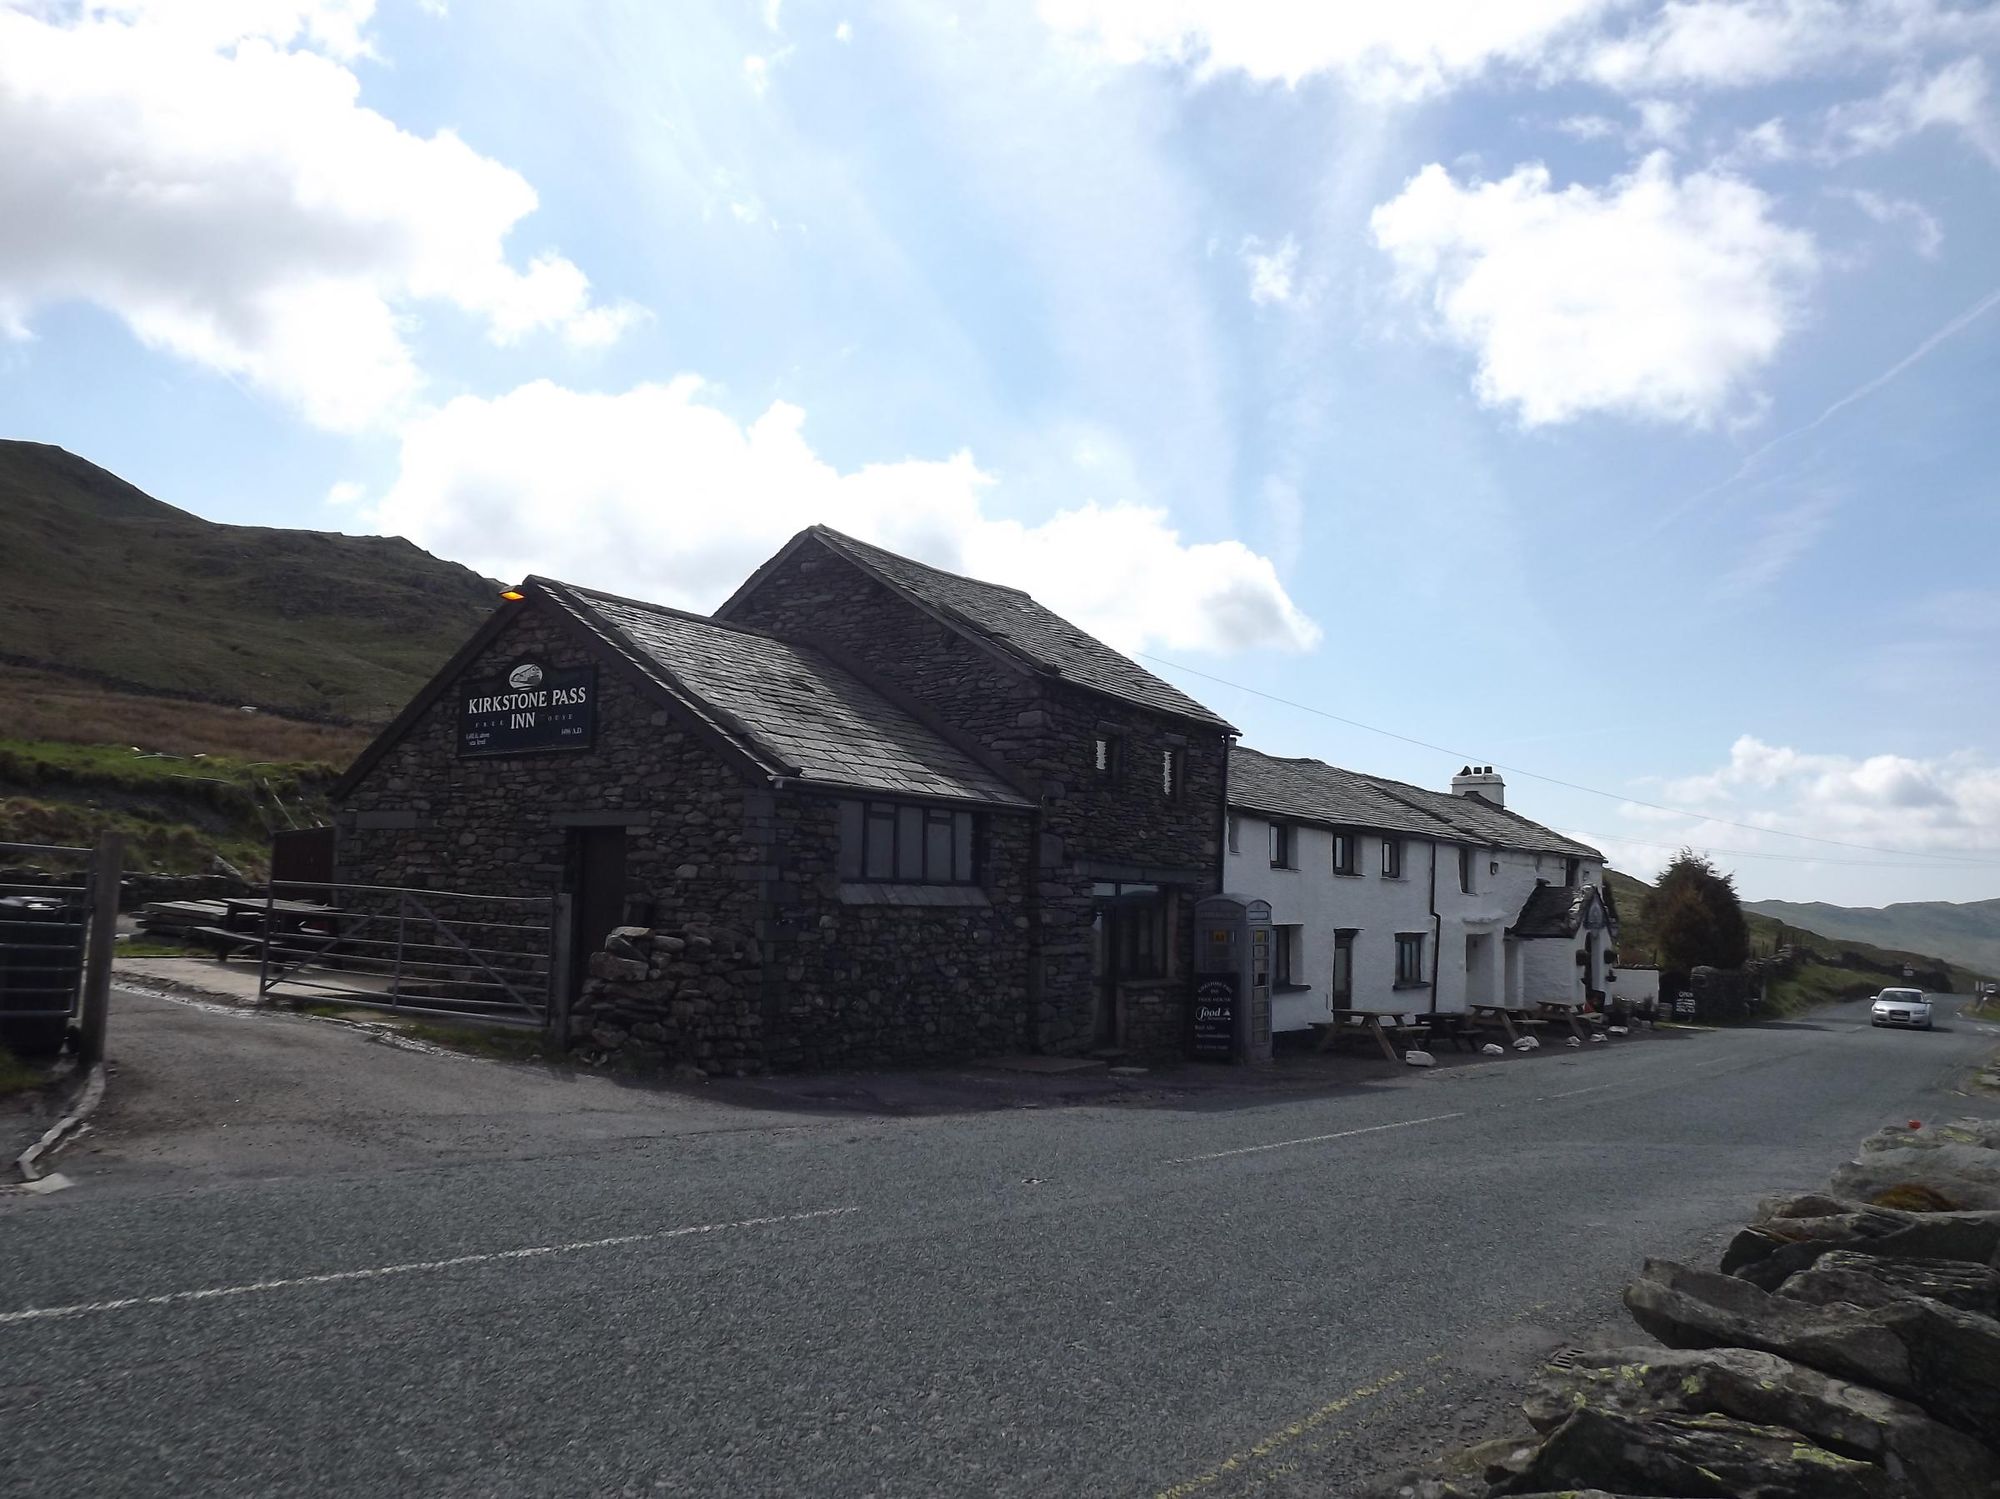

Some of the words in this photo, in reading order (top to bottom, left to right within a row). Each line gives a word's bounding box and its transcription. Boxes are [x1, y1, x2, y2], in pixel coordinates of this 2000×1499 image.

[468, 691, 548, 714] KIRKSTONE
[551, 687, 586, 706] PASS
[510, 712, 536, 730] INN
[1199, 1006, 1221, 1020] food
